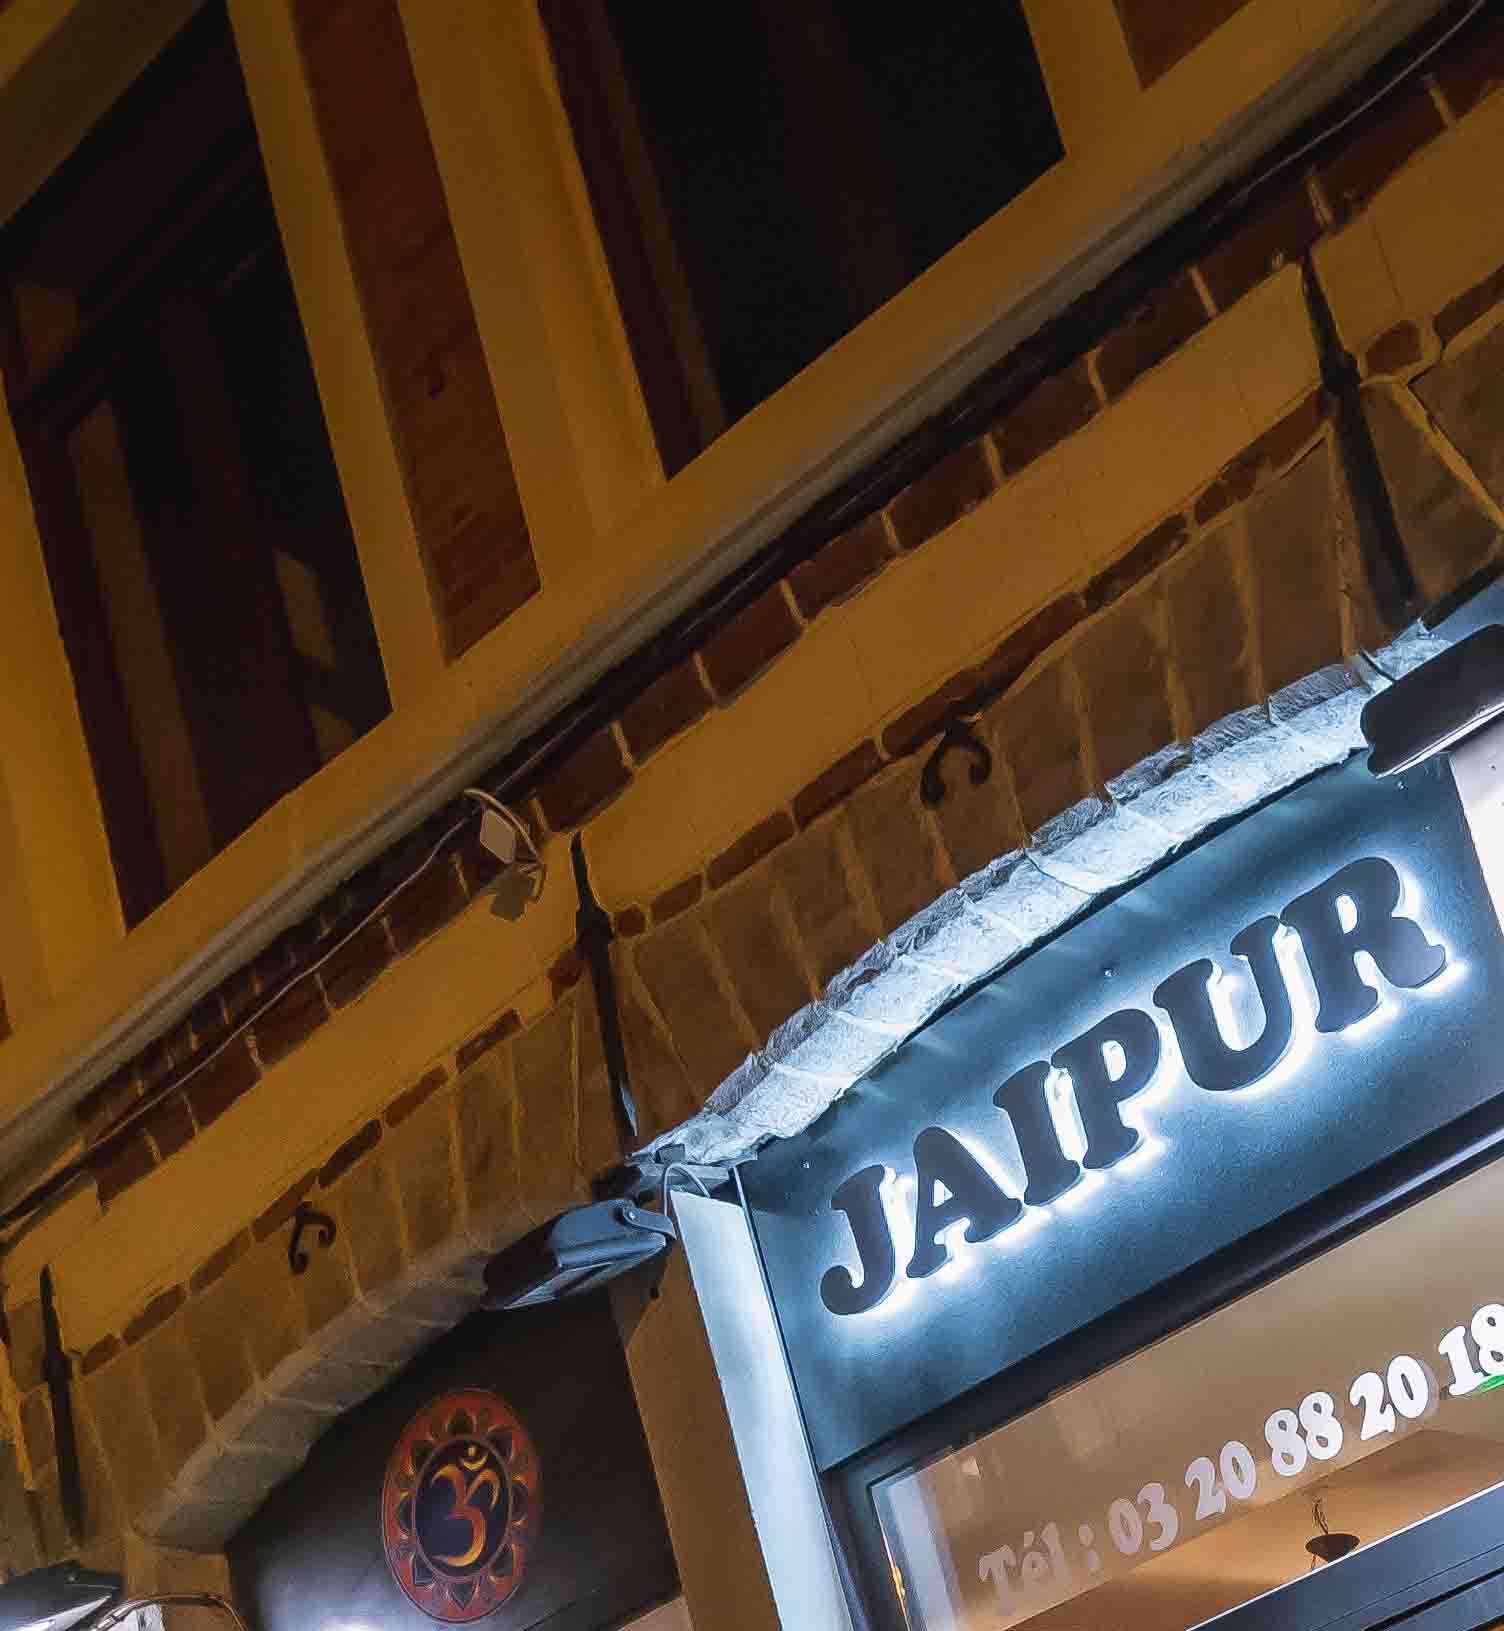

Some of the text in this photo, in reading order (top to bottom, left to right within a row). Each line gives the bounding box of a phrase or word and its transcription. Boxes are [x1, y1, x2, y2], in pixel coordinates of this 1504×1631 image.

[819, 856, 1447, 1316] JAIPUR
[978, 1518, 1072, 1608] Tél
[1108, 1481, 1178, 1556] 03
[1185, 1439, 1256, 1520] 20
[1264, 1390, 1344, 1477] 88
[1350, 1354, 1430, 1441] 20
